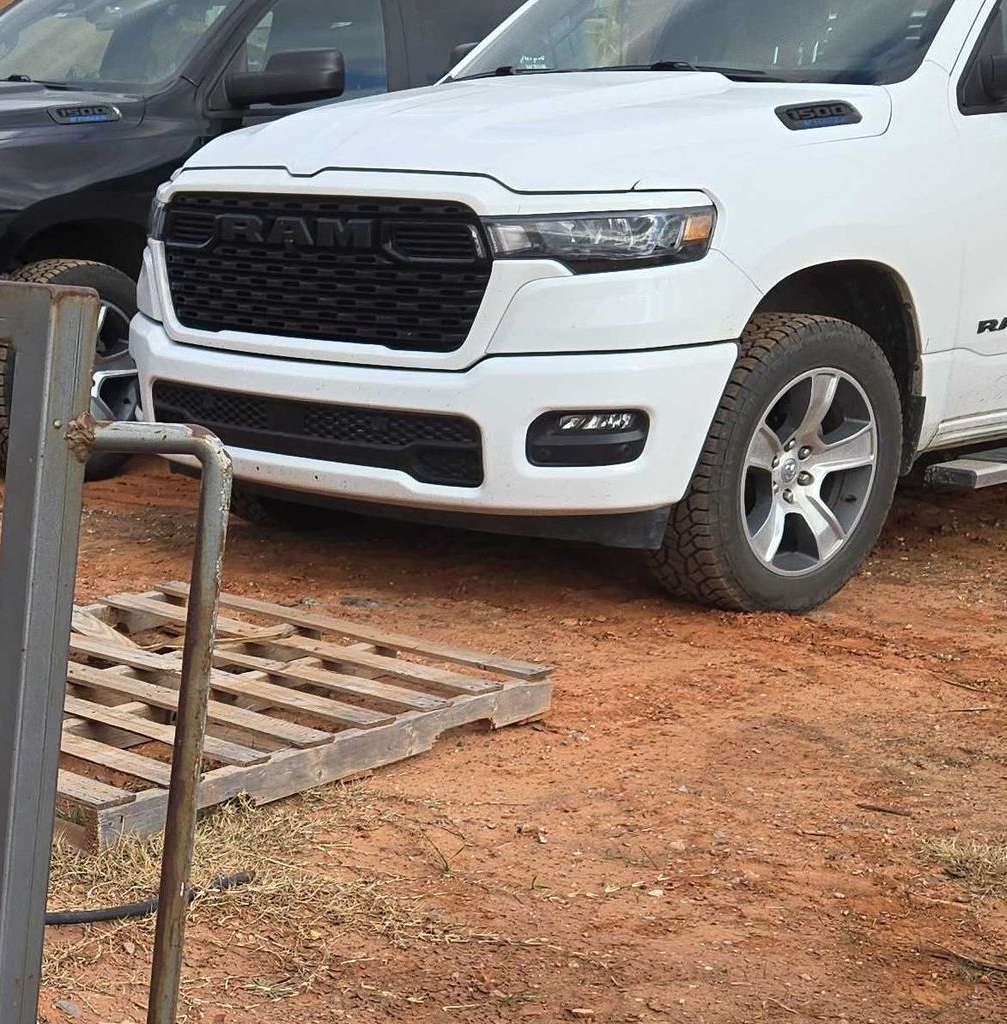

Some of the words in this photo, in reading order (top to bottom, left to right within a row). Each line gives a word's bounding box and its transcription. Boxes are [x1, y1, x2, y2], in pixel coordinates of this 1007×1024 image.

[57, 107, 107, 117] 1500
[787, 105, 847, 120] 1500
[216, 213, 373, 248] RAM
